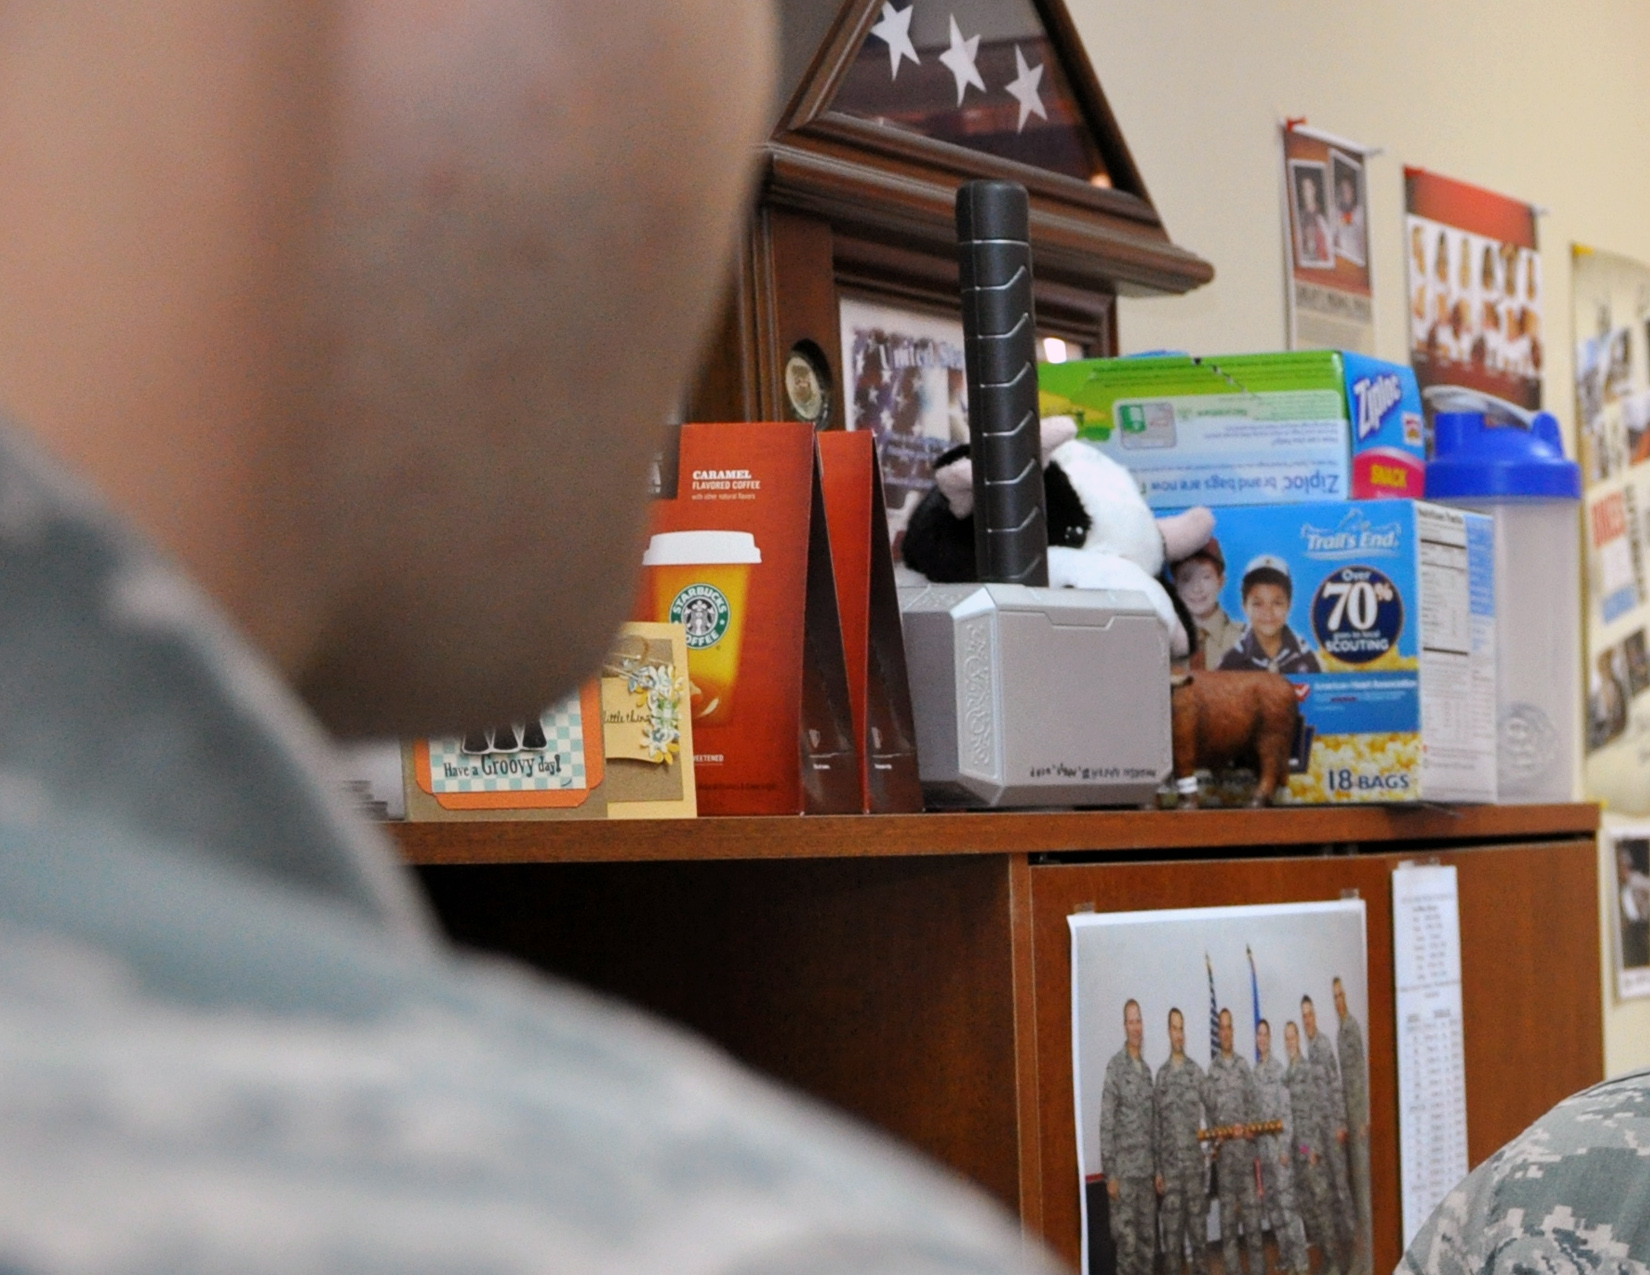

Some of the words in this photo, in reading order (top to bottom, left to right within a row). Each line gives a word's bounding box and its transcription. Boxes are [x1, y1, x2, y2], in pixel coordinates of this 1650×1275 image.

[1354, 375, 1402, 440] Ziploc
[692, 469, 752, 480] CARAMEL
[1284, 470, 1339, 494] Ziploc
[692, 481, 730, 491] FLAVORED
[732, 480, 761, 490] COFFEE
[1307, 533, 1357, 550] Trail's
[1341, 569, 1371, 581] Over
[672, 586, 728, 614] STARBUCKS
[1322, 581, 1394, 631] 70%
[686, 629, 720, 647] OFFEE
[1324, 638, 1390, 653] SCOUTING
[444, 762, 470, 778] Have
[472, 765, 479, 776] a
[481, 753, 535, 778] Groovy
[538, 754, 561, 776] day!
[1328, 769, 1354, 792] 18
[1358, 774, 1409, 790] BAGS
